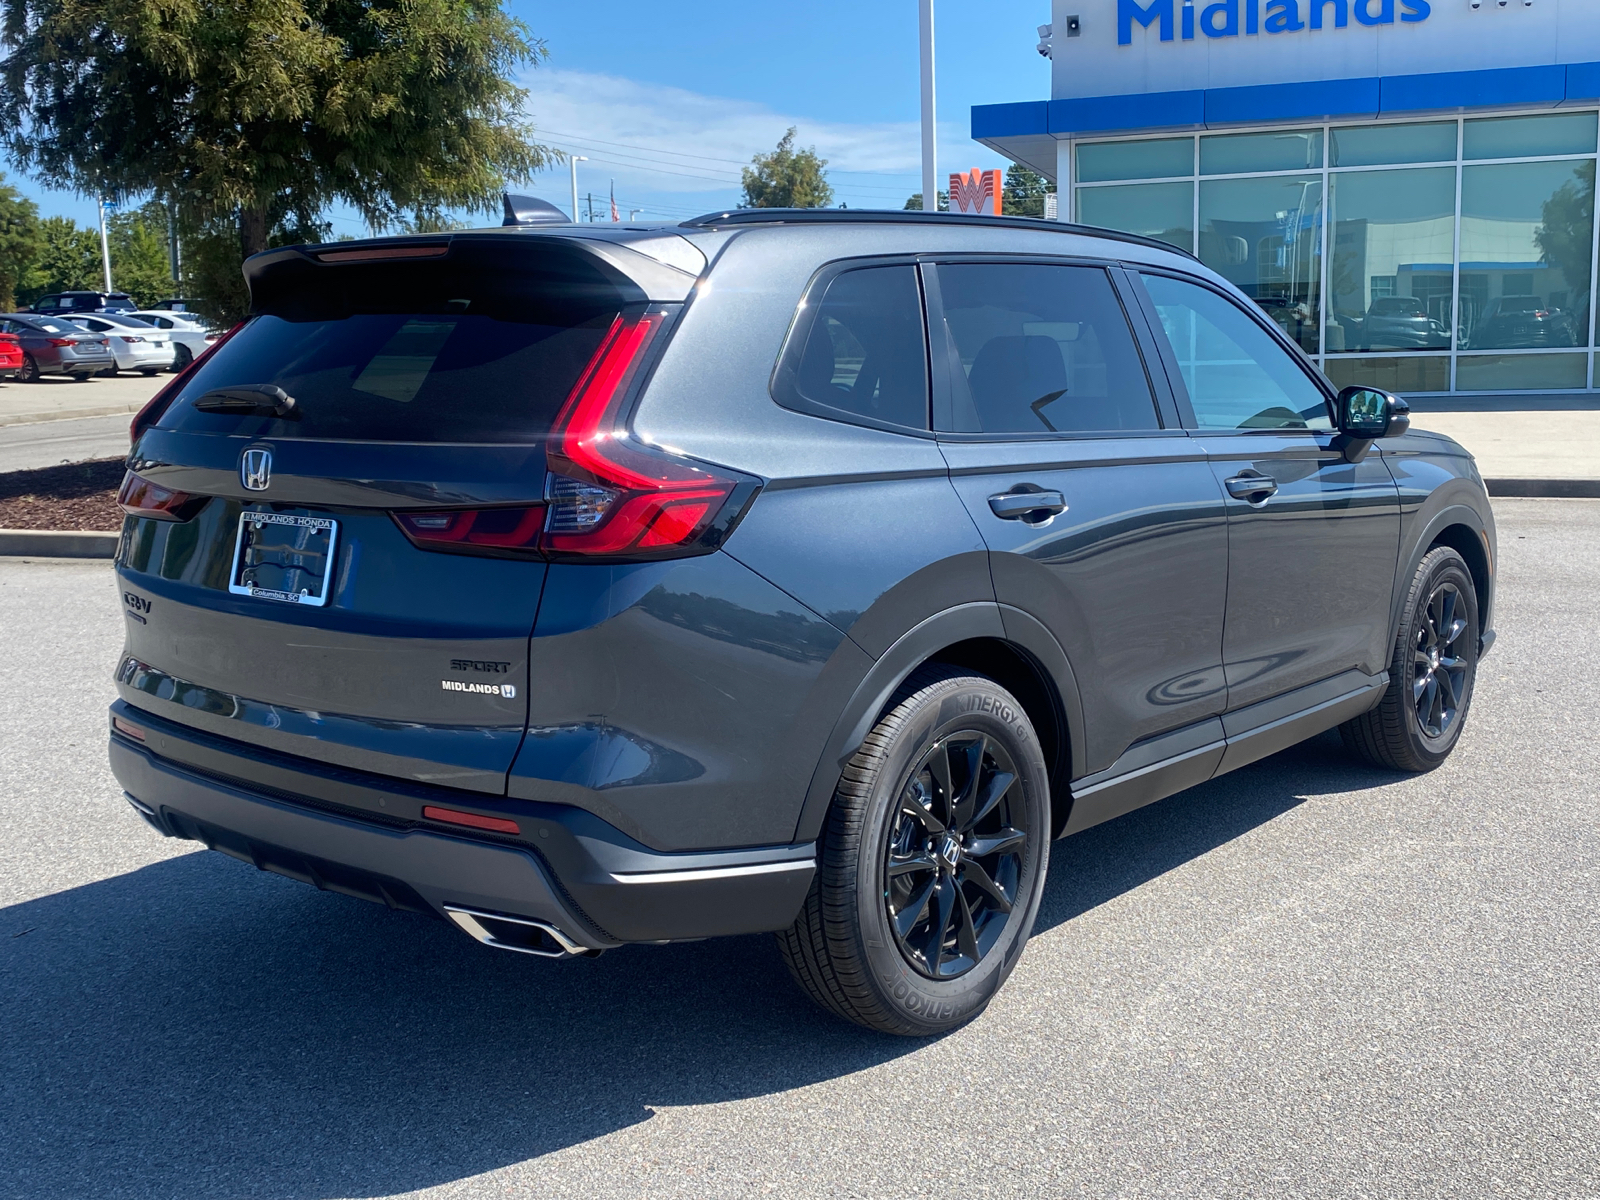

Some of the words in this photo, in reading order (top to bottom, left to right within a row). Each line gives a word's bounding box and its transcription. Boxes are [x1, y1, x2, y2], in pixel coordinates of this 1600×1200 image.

[1117, 0, 1431, 46] Midlands
[250, 513, 295, 525] MIDLANDS
[298, 518, 330, 528] HONDA
[287, 593, 299, 602] SC
[450, 659, 511, 673] SPORT
[441, 680, 500, 695] MIDLANDS
